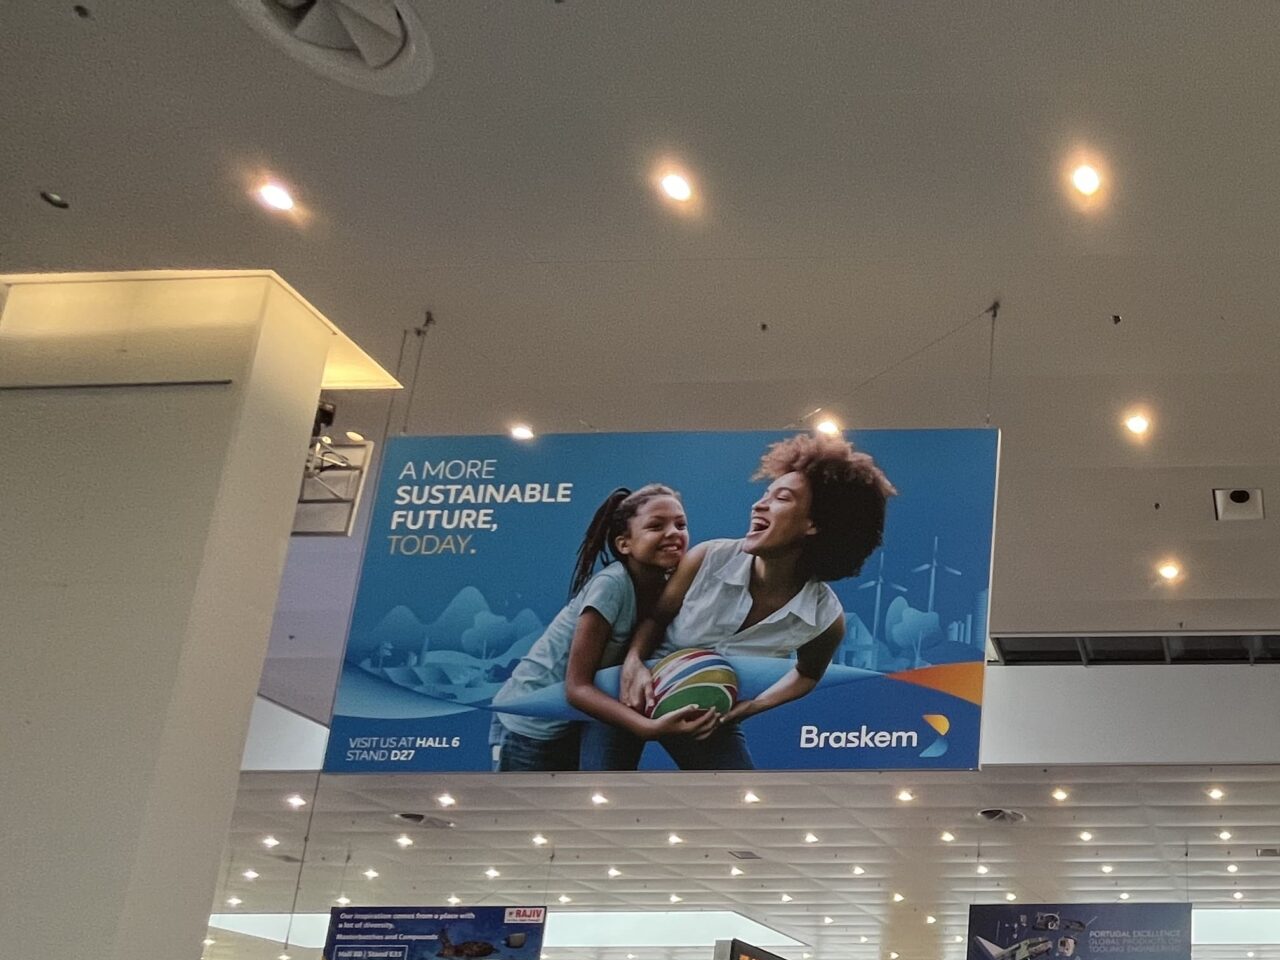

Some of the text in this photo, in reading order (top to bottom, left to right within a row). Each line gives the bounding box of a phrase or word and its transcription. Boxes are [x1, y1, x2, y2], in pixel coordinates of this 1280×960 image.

[398, 459, 498, 480] A MORE
[394, 482, 574, 505] SUSTAINABLE
[390, 508, 498, 532] FUTURE,
[387, 534, 477, 555] TODAY.
[349, 736, 460, 748] VISIT US AT HALL 6
[799, 725, 918, 748] Braskem
[345, 749, 416, 761] STAND D27
[516, 909, 542, 918] RAJIV
